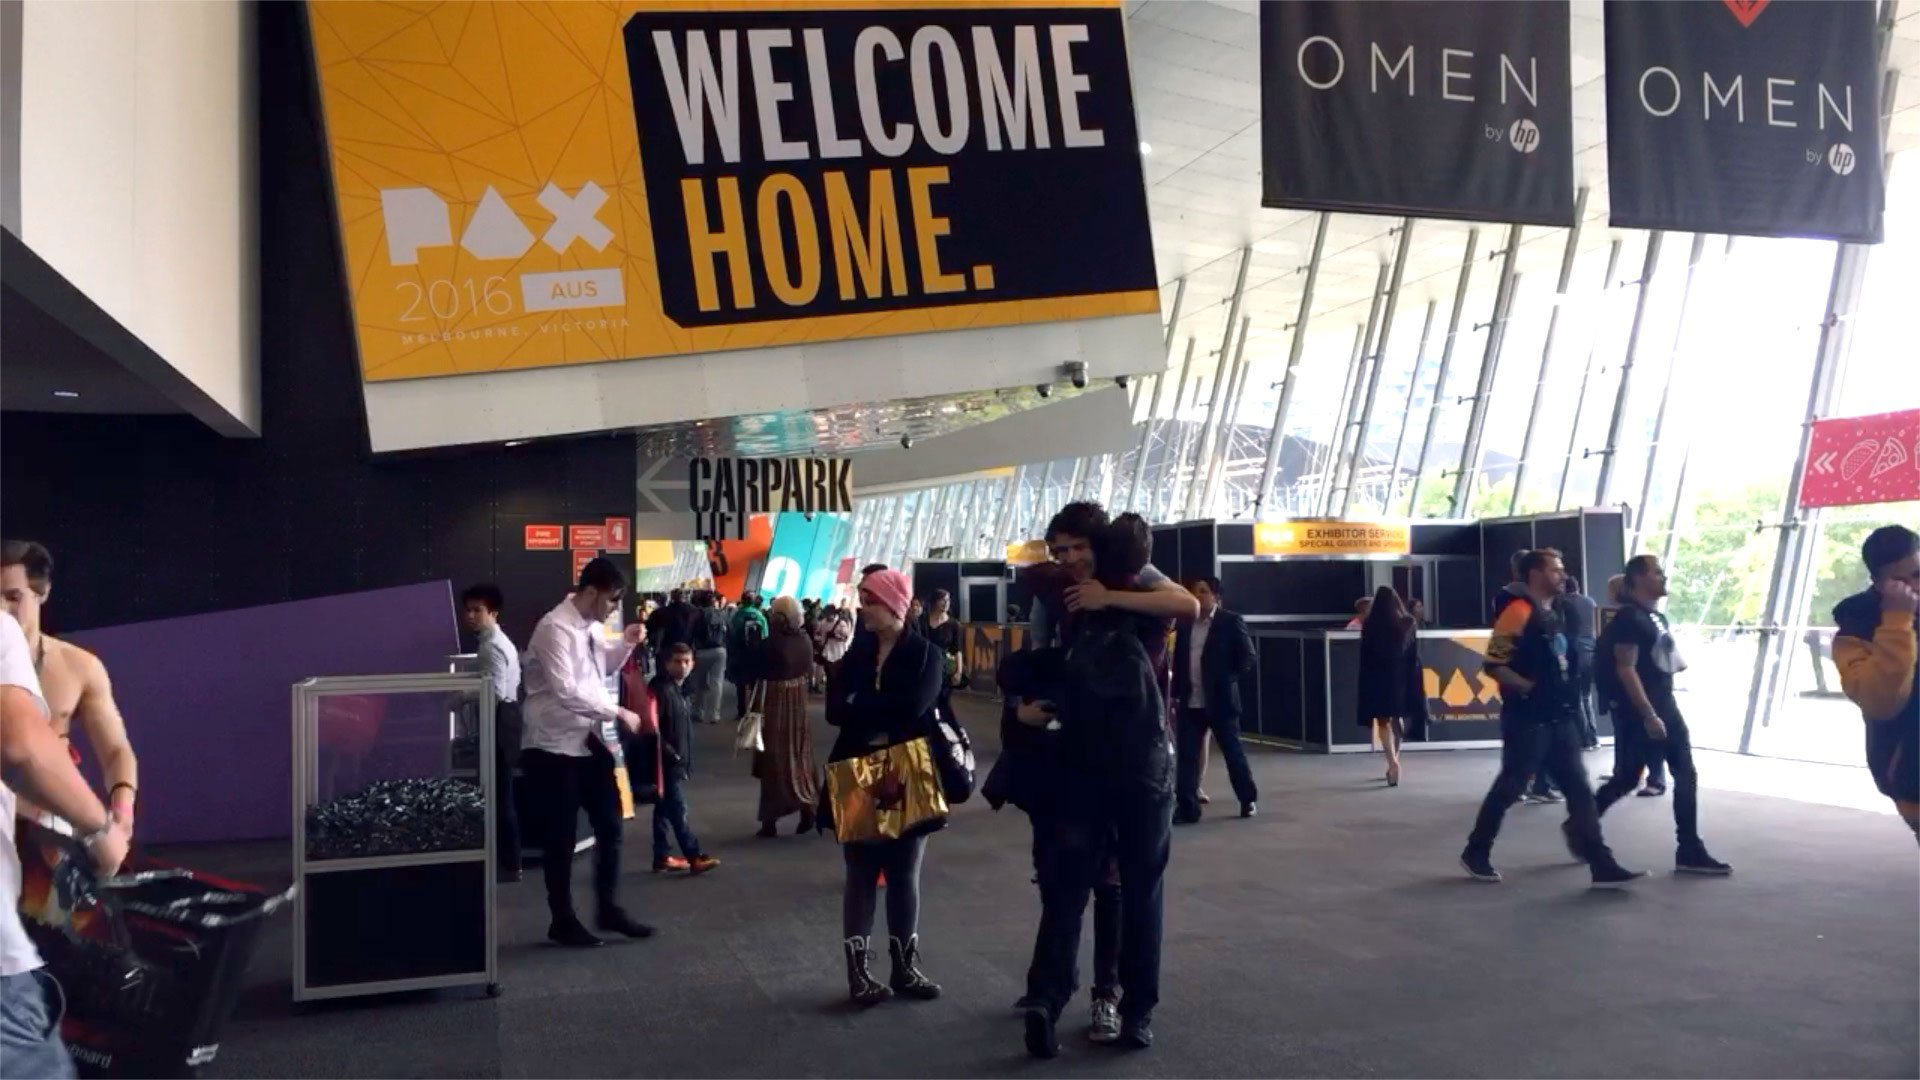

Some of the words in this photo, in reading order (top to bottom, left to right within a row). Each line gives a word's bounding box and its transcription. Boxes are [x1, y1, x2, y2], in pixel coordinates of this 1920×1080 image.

[651, 24, 1105, 165] WELCOME
[1298, 36, 1537, 107] OMEN
[1639, 66, 1854, 132] OMEN
[1485, 123, 1504, 143] by
[1510, 118, 1539, 152] hp
[1806, 149, 1823, 166] by
[1829, 142, 1855, 175] hp
[380, 180, 616, 265] PAX
[680, 167, 995, 312] HOME.
[396, 275, 513, 323] 2016
[550, 280, 598, 300] AUS
[400, 325, 530, 345] MELBOURNE,
[540, 317, 630, 335] VICTORIA
[689, 457, 852, 512] CARPARK
[1299, 540, 1335, 548] SPECIAL
[1307, 528, 1366, 539] EXHIBITOR
